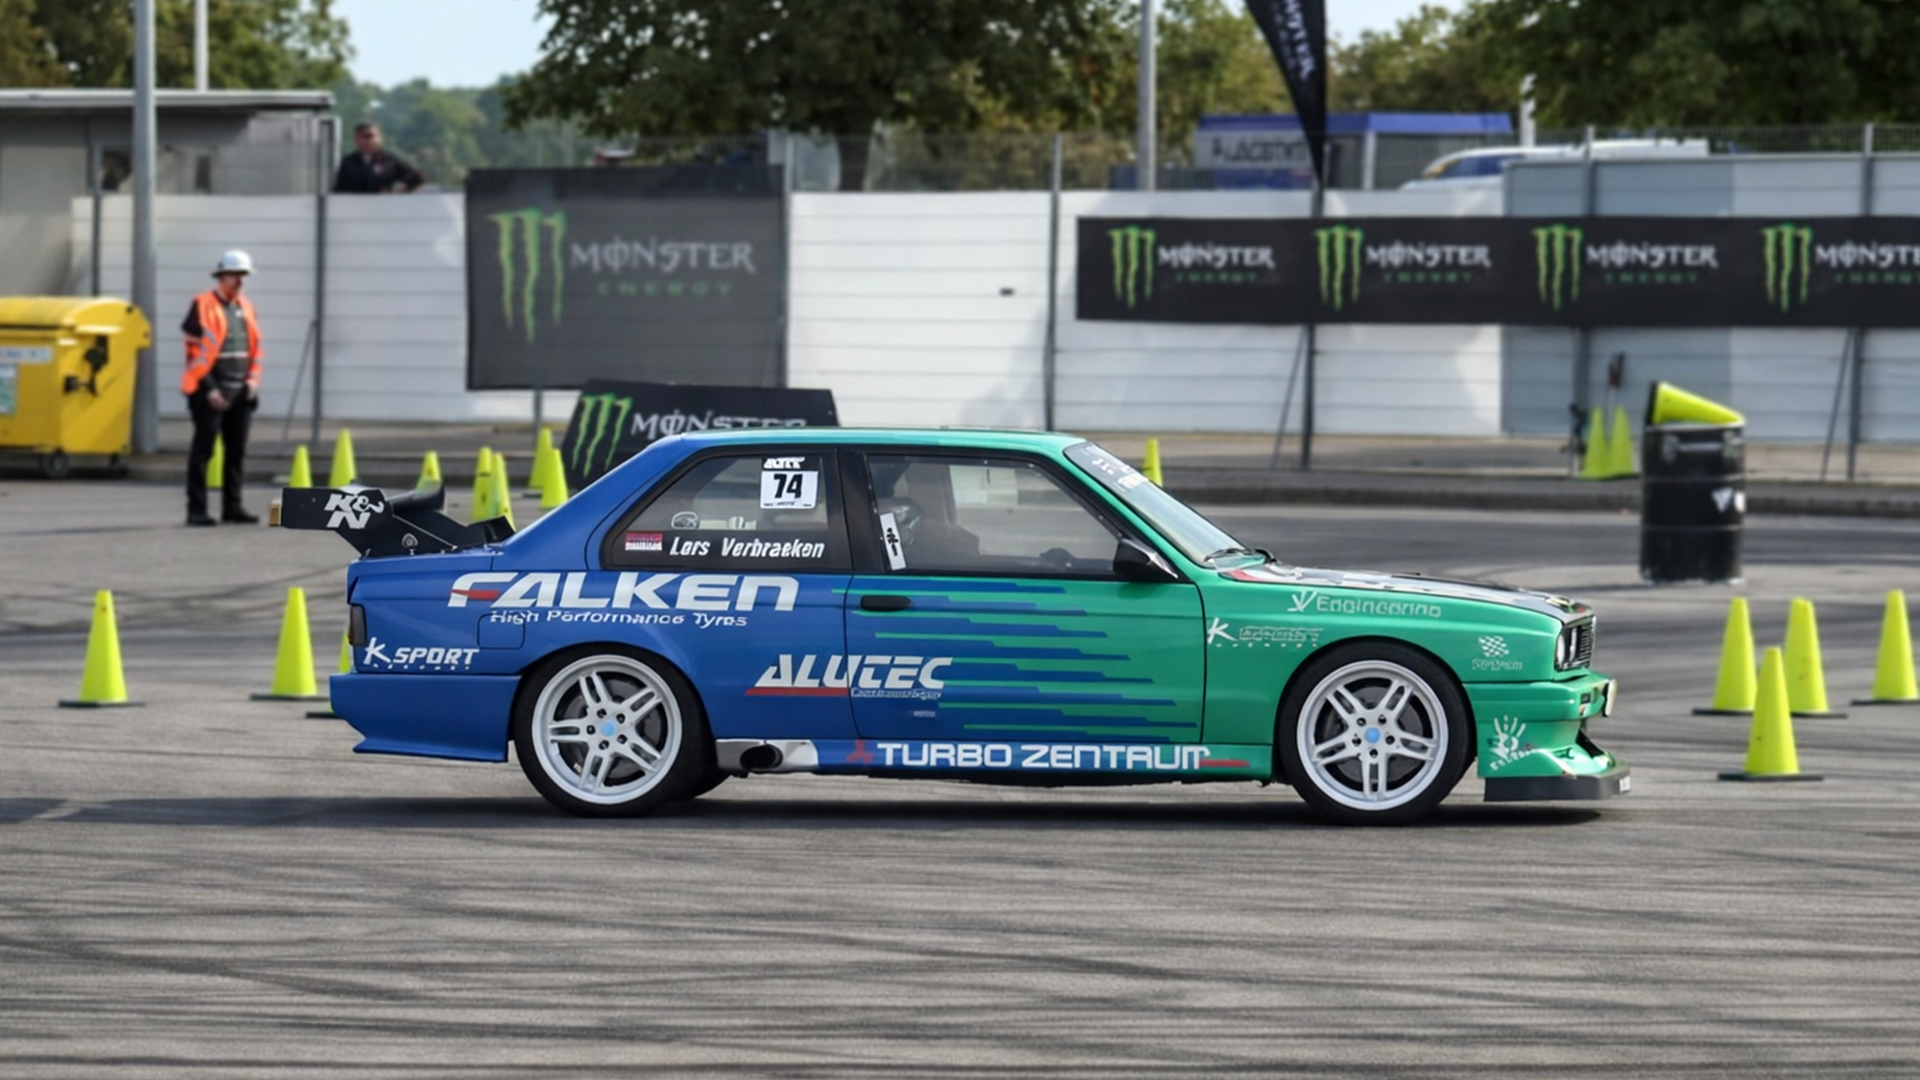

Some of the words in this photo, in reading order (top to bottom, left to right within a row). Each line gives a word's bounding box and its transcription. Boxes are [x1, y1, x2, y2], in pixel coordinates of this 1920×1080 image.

[570, 236, 755, 274] MONSTER
[1158, 241, 1275, 269] MONSTER
[1366, 241, 1492, 268] MONSTER
[1586, 240, 1719, 269] MONSTER
[597, 280, 732, 297] ENERGY
[774, 473, 803, 499] 74
[447, 571, 799, 612] FALKEN
[490, 610, 540, 625] High
[393, 647, 480, 665] SPORT
[754, 654, 954, 690] ALUTEC
[877, 742, 1013, 768] TURBO
